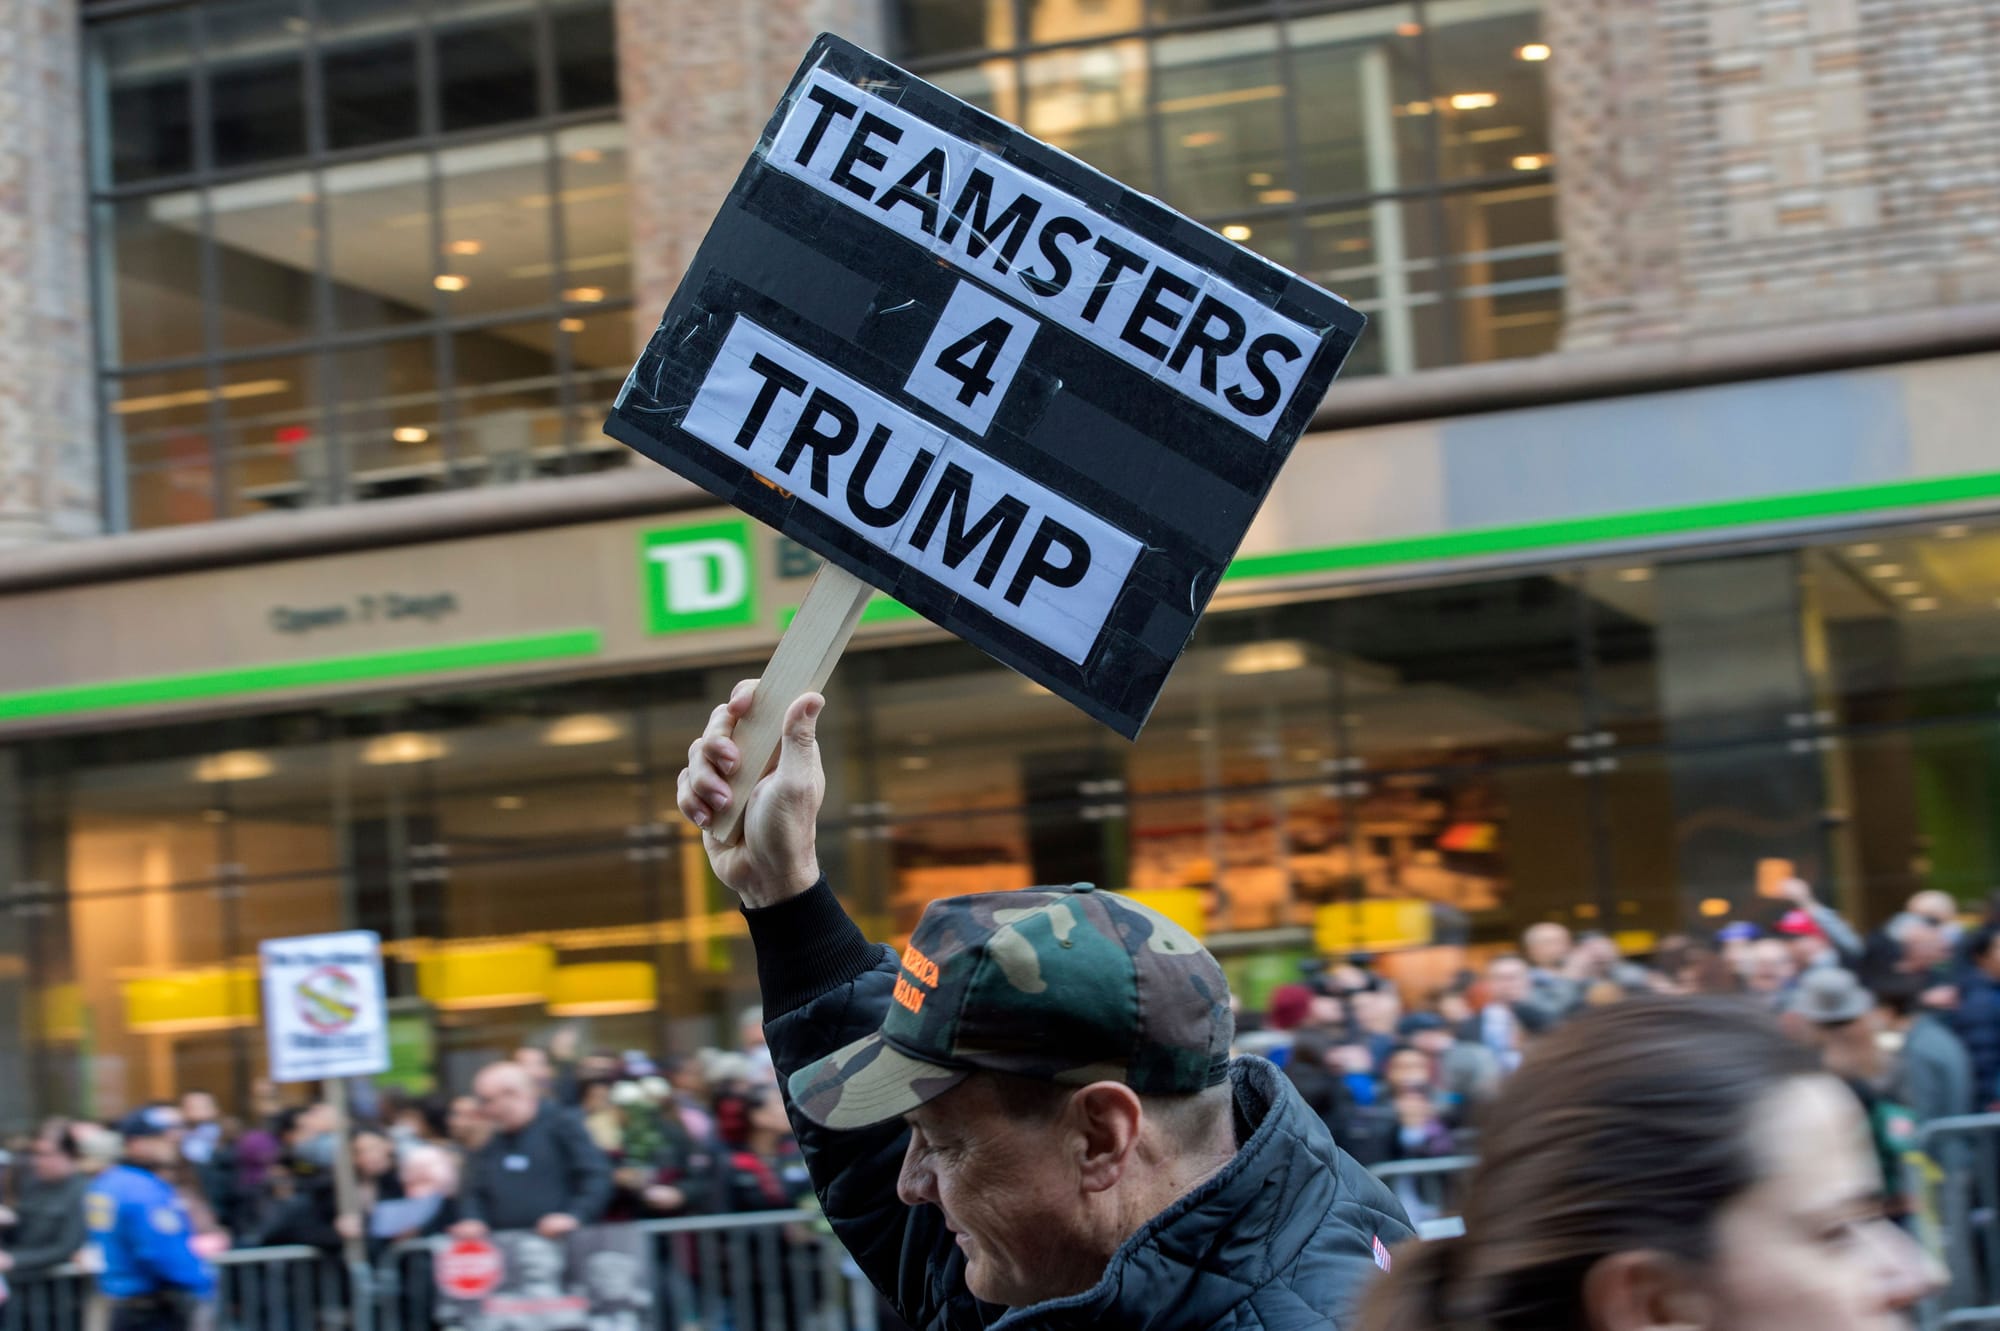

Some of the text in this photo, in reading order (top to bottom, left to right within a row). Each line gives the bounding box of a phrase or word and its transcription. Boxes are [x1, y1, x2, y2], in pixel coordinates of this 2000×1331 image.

[794, 84, 1303, 417] TEAMSTERS
[934, 316, 1014, 408] 4
[733, 352, 1092, 607] TRUMP
[647, 537, 747, 615] TD
